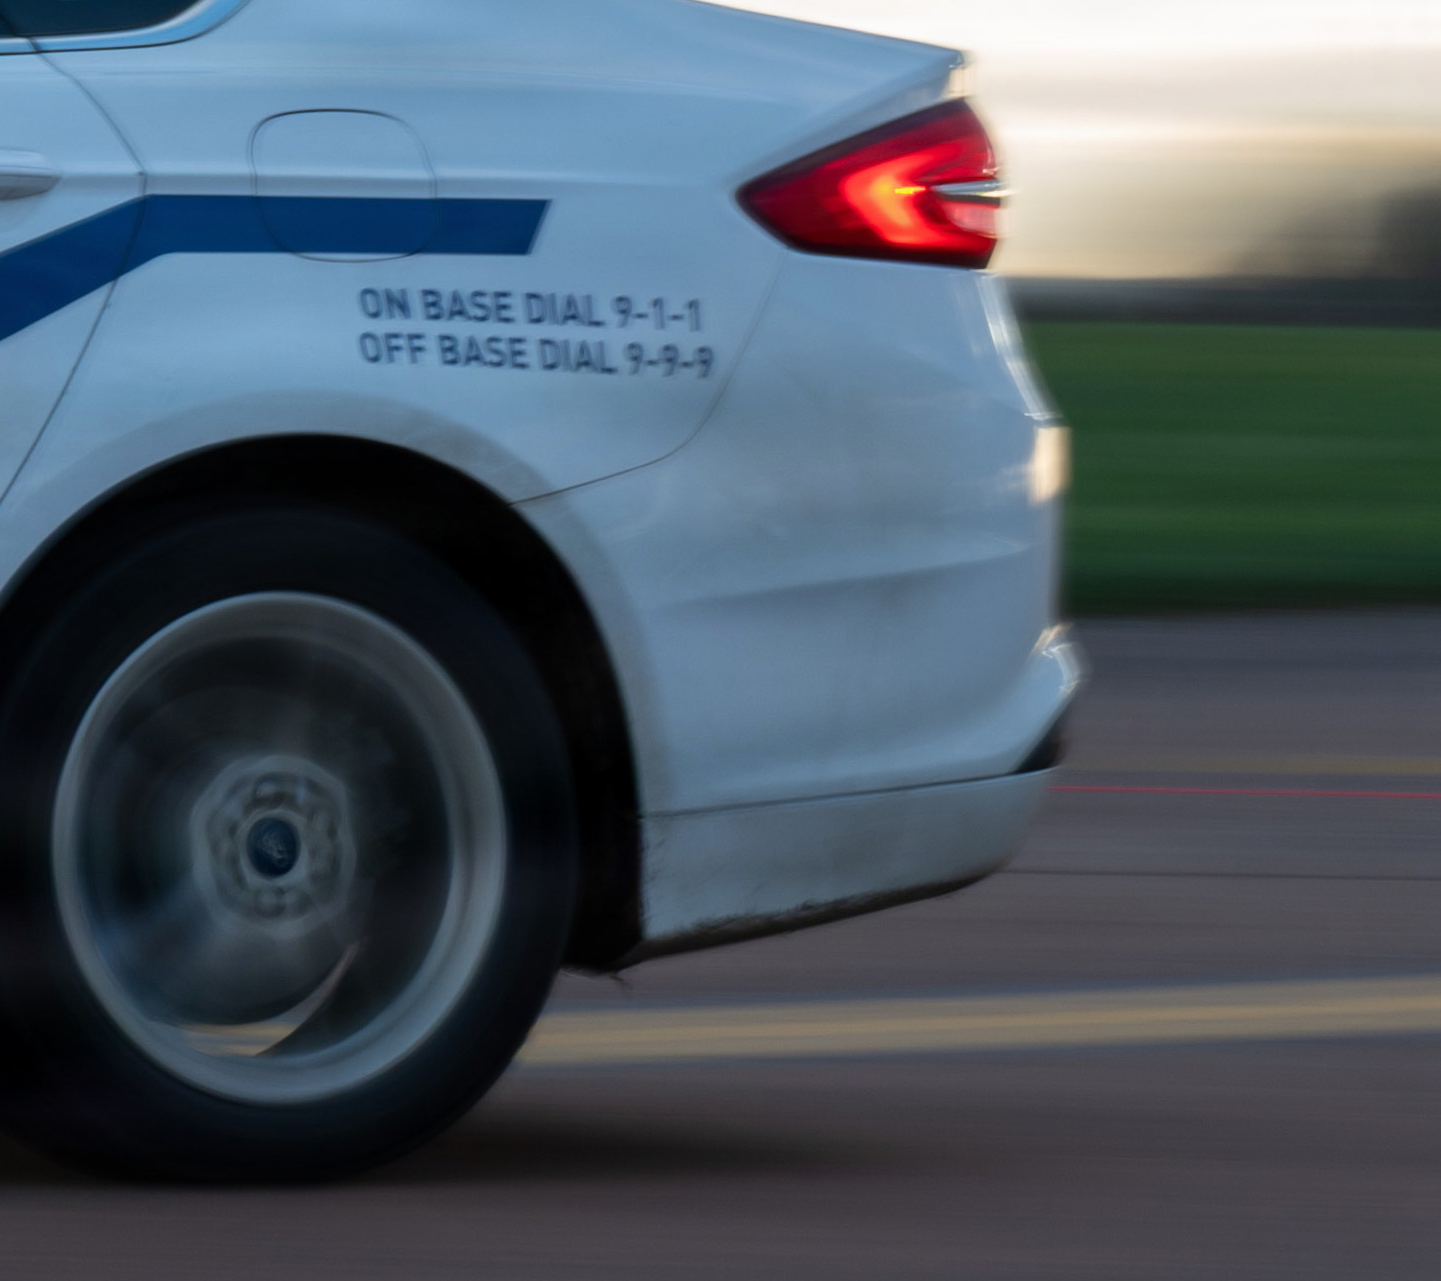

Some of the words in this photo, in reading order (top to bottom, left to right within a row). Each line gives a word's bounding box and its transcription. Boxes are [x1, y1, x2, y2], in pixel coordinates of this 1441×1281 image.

[358, 287, 412, 320] ON
[420, 288, 516, 324] BASE
[524, 291, 607, 327] DIAL
[612, 294, 702, 333] 9-1-1
[358, 331, 427, 366] OFF
[438, 333, 529, 371] BASE
[537, 337, 620, 376] DIAL
[623, 341, 715, 380] 9-9-9
